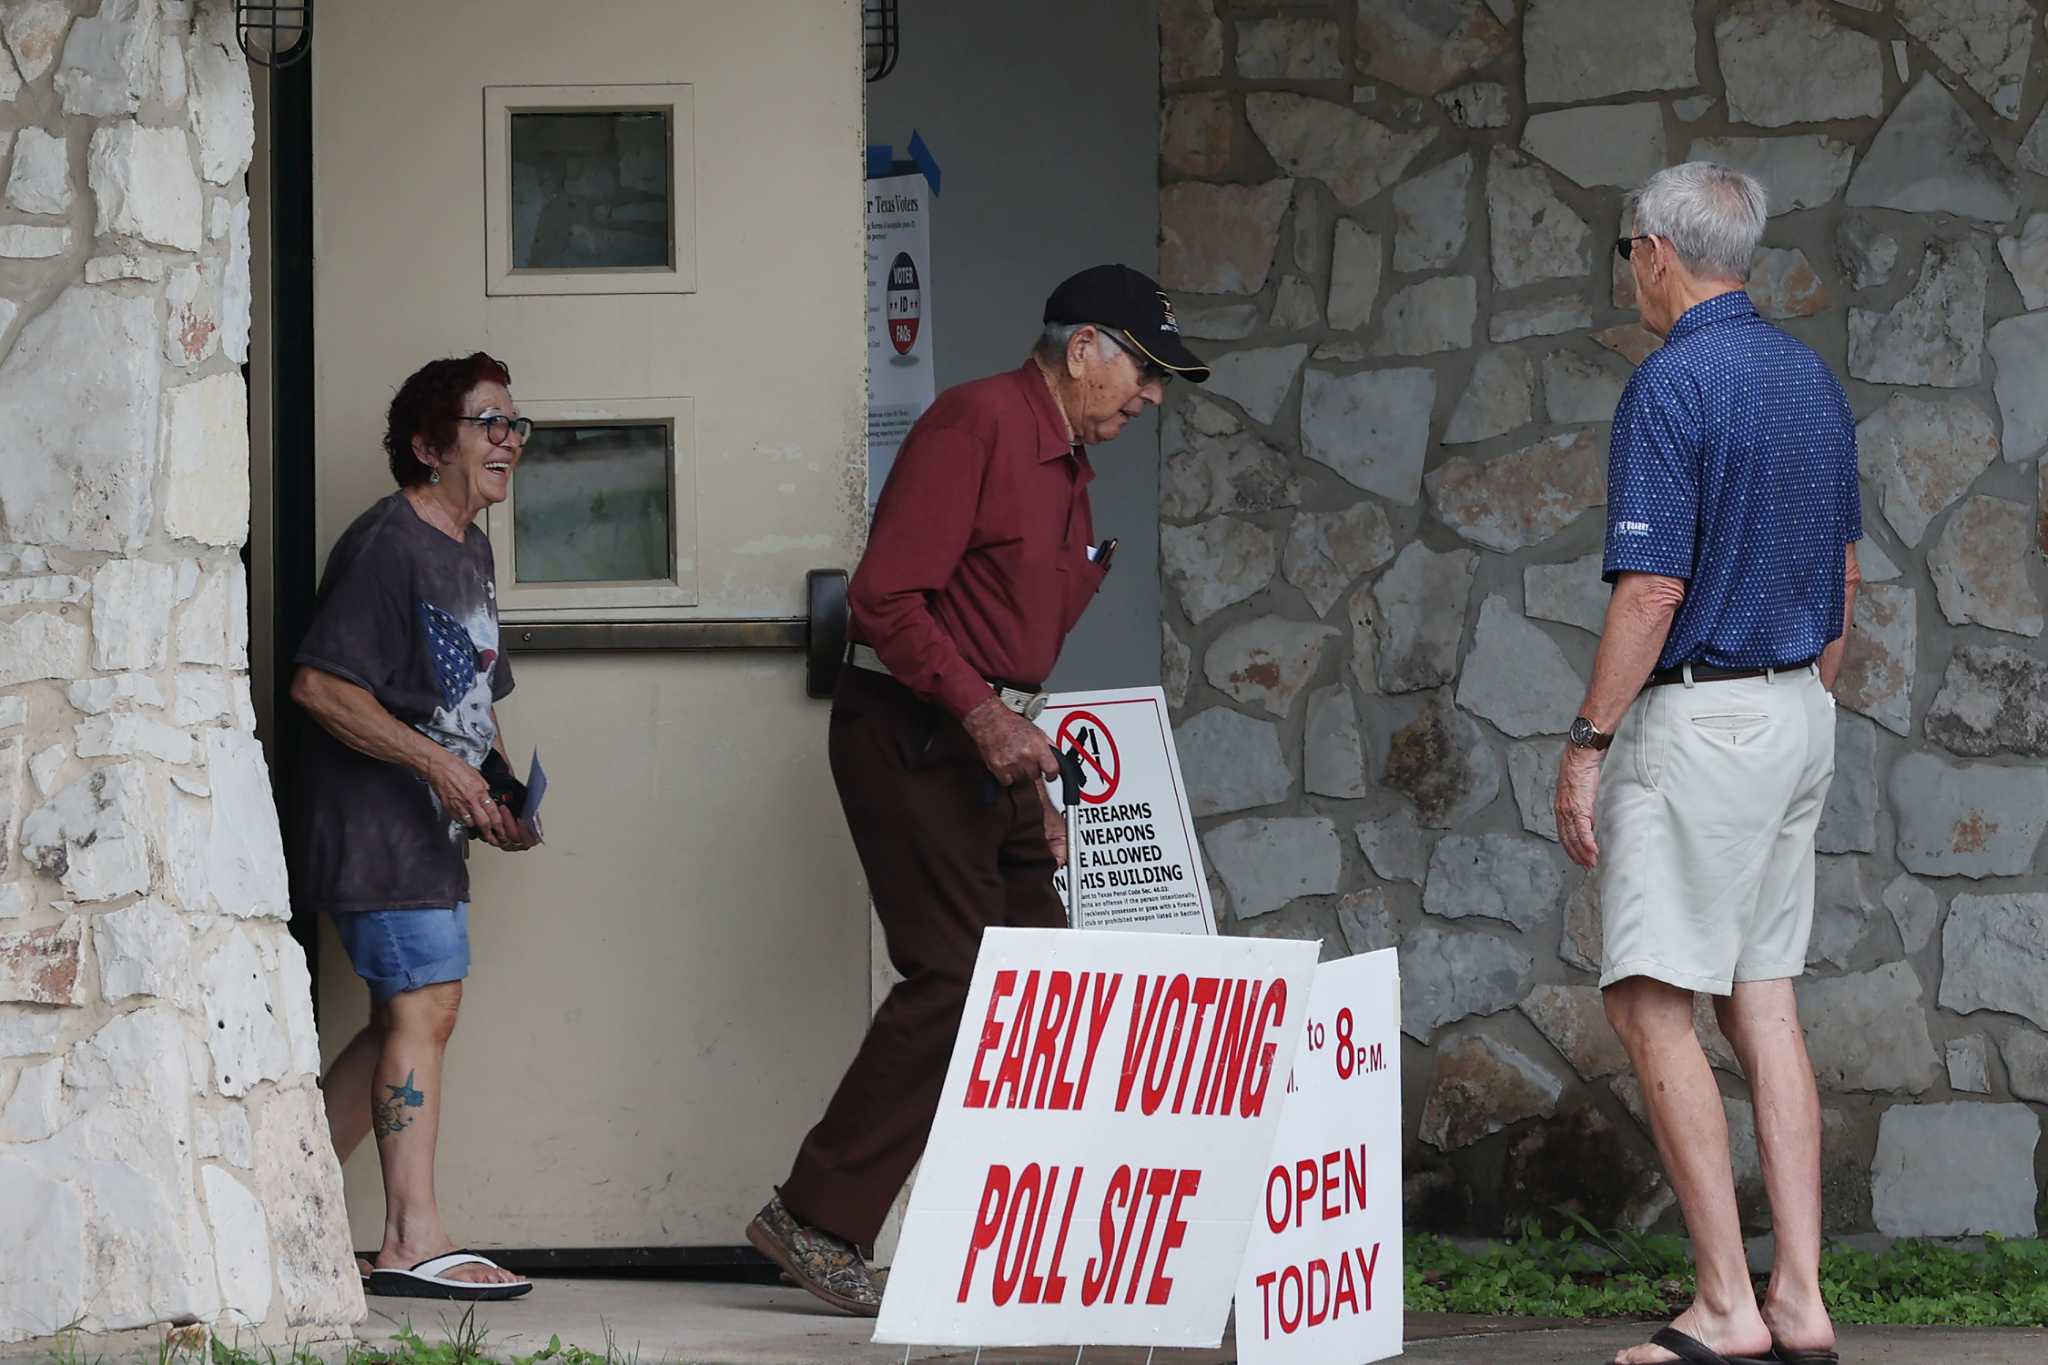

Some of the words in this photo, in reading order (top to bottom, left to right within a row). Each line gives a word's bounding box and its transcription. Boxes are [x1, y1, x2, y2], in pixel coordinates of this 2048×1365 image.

[893, 266, 914, 285] VOTER
[899, 295, 909, 313] ID
[896, 324, 911, 342] FAQs
[1078, 803, 1152, 825] FIREARMS
[1080, 824, 1156, 846] WEAPONS
[1092, 845, 1163, 868] ALLOWED
[1080, 872, 1106, 890] HIS
[1109, 864, 1184, 887] BUILDING
[1112, 907, 1137, 916] possesses
[1145, 905, 1158, 913] goes
[1140, 896, 1159, 904] person
[1104, 916, 1132, 926] prohibited
[1133, 914, 1155, 922] weapon
[1156, 911, 1172, 919] listed
[1179, 909, 1200, 917] Section
[963, 970, 1123, 1111] EARLY
[1114, 972, 1287, 1118] VOTING
[1306, 1017, 1325, 1051] to
[1336, 1007, 1355, 1080] 8
[1357, 1043, 1387, 1075] P.M.
[1266, 1143, 1367, 1234] OPEN
[956, 1161, 1085, 1308] POLL
[1081, 1163, 1202, 1308] SITE
[1256, 1242, 1380, 1340] TODAY
